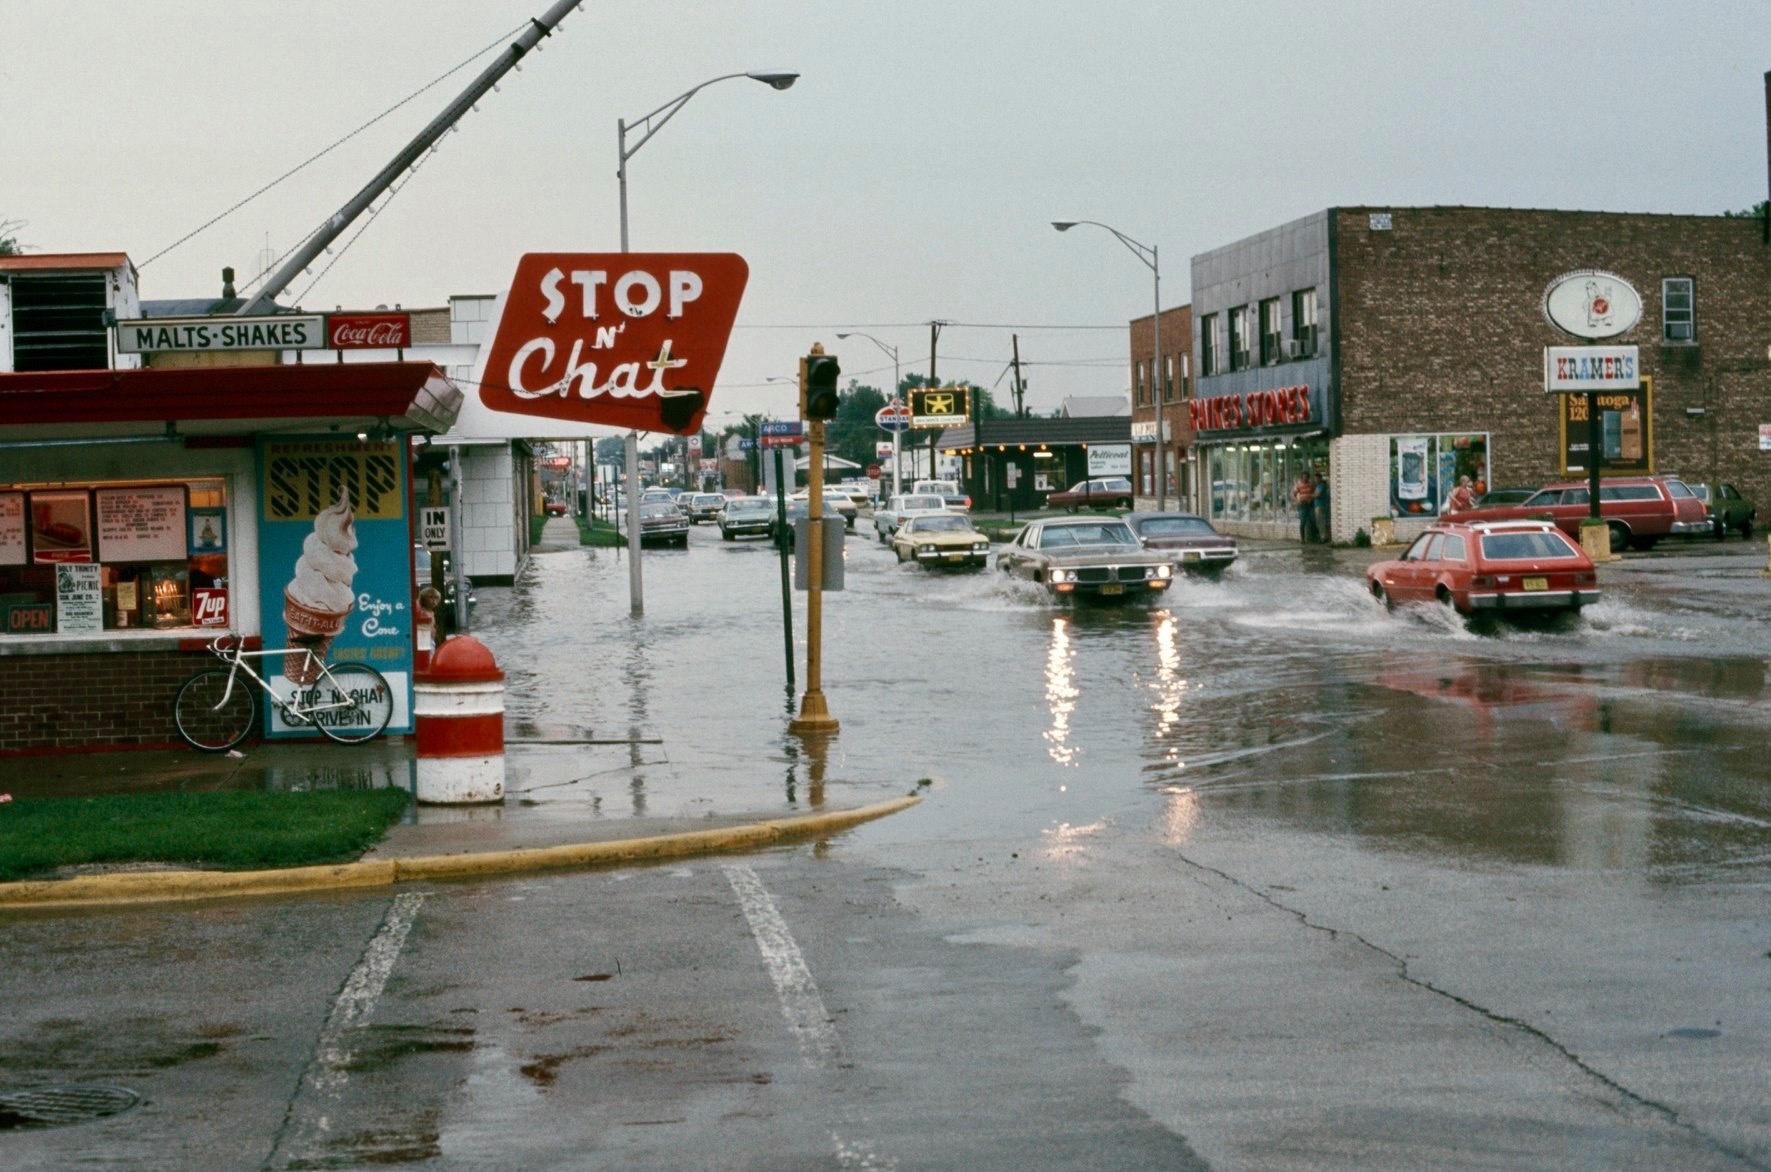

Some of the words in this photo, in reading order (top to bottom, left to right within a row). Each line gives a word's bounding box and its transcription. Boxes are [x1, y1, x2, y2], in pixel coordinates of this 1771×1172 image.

[540, 267, 703, 324] STOP
[508, 337, 699, 399] Chat
[1557, 355, 1634, 380] KRAMER'S
[1247, 385, 1310, 427] STORES
[1568, 392, 1630, 410] Satoga
[763, 424, 788, 432] ARCO
[879, 415, 909, 423] STANA
[271, 441, 394, 454] REFRESHMENT
[270, 454, 396, 517] STOP
[426, 511, 446, 525] IN
[425, 527, 446, 539] ONLY
[76, 581, 99, 591] PICNIC
[358, 593, 392, 616] Enjoy
[395, 602, 404, 610] a
[10, 609, 49, 629] OPEN
[361, 617, 400, 637] Cone
[291, 689, 322, 705] STOP
[350, 688, 384, 703] CHAT
